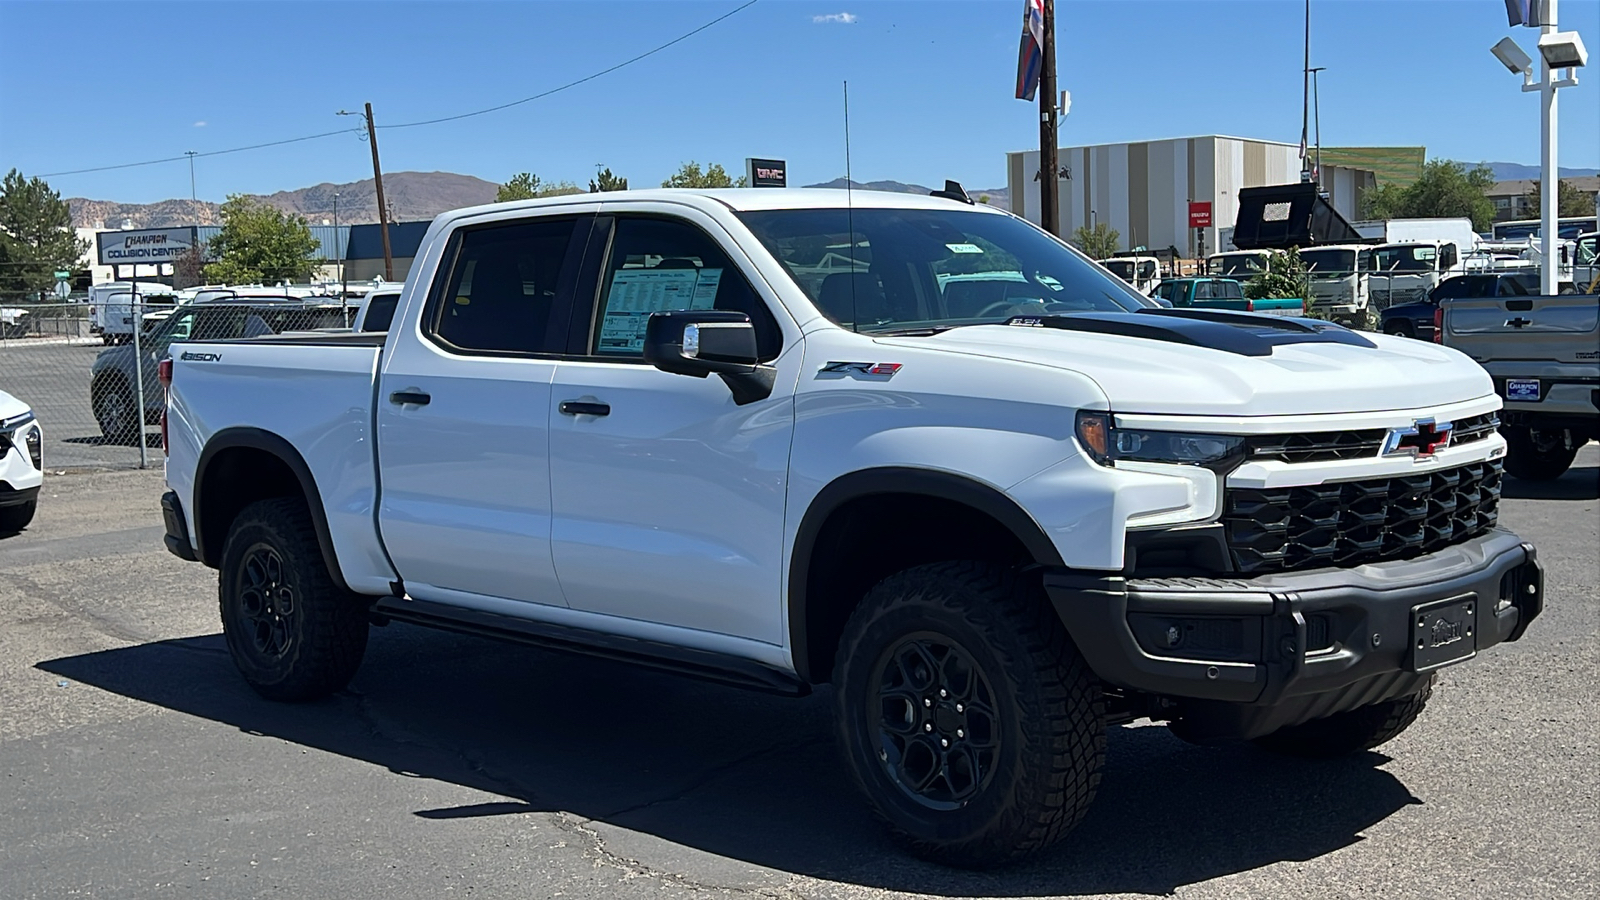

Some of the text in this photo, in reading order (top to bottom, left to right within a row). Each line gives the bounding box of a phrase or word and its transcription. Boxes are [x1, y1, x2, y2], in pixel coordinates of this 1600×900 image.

[757, 168, 784, 179] GMC
[125, 234, 167, 248] CHAMPION
[107, 246, 186, 259] COLLISION CENTER
[184, 352, 222, 362] BISON
[816, 360, 903, 377] ZR2
[1508, 382, 1538, 390] CHAMPION
